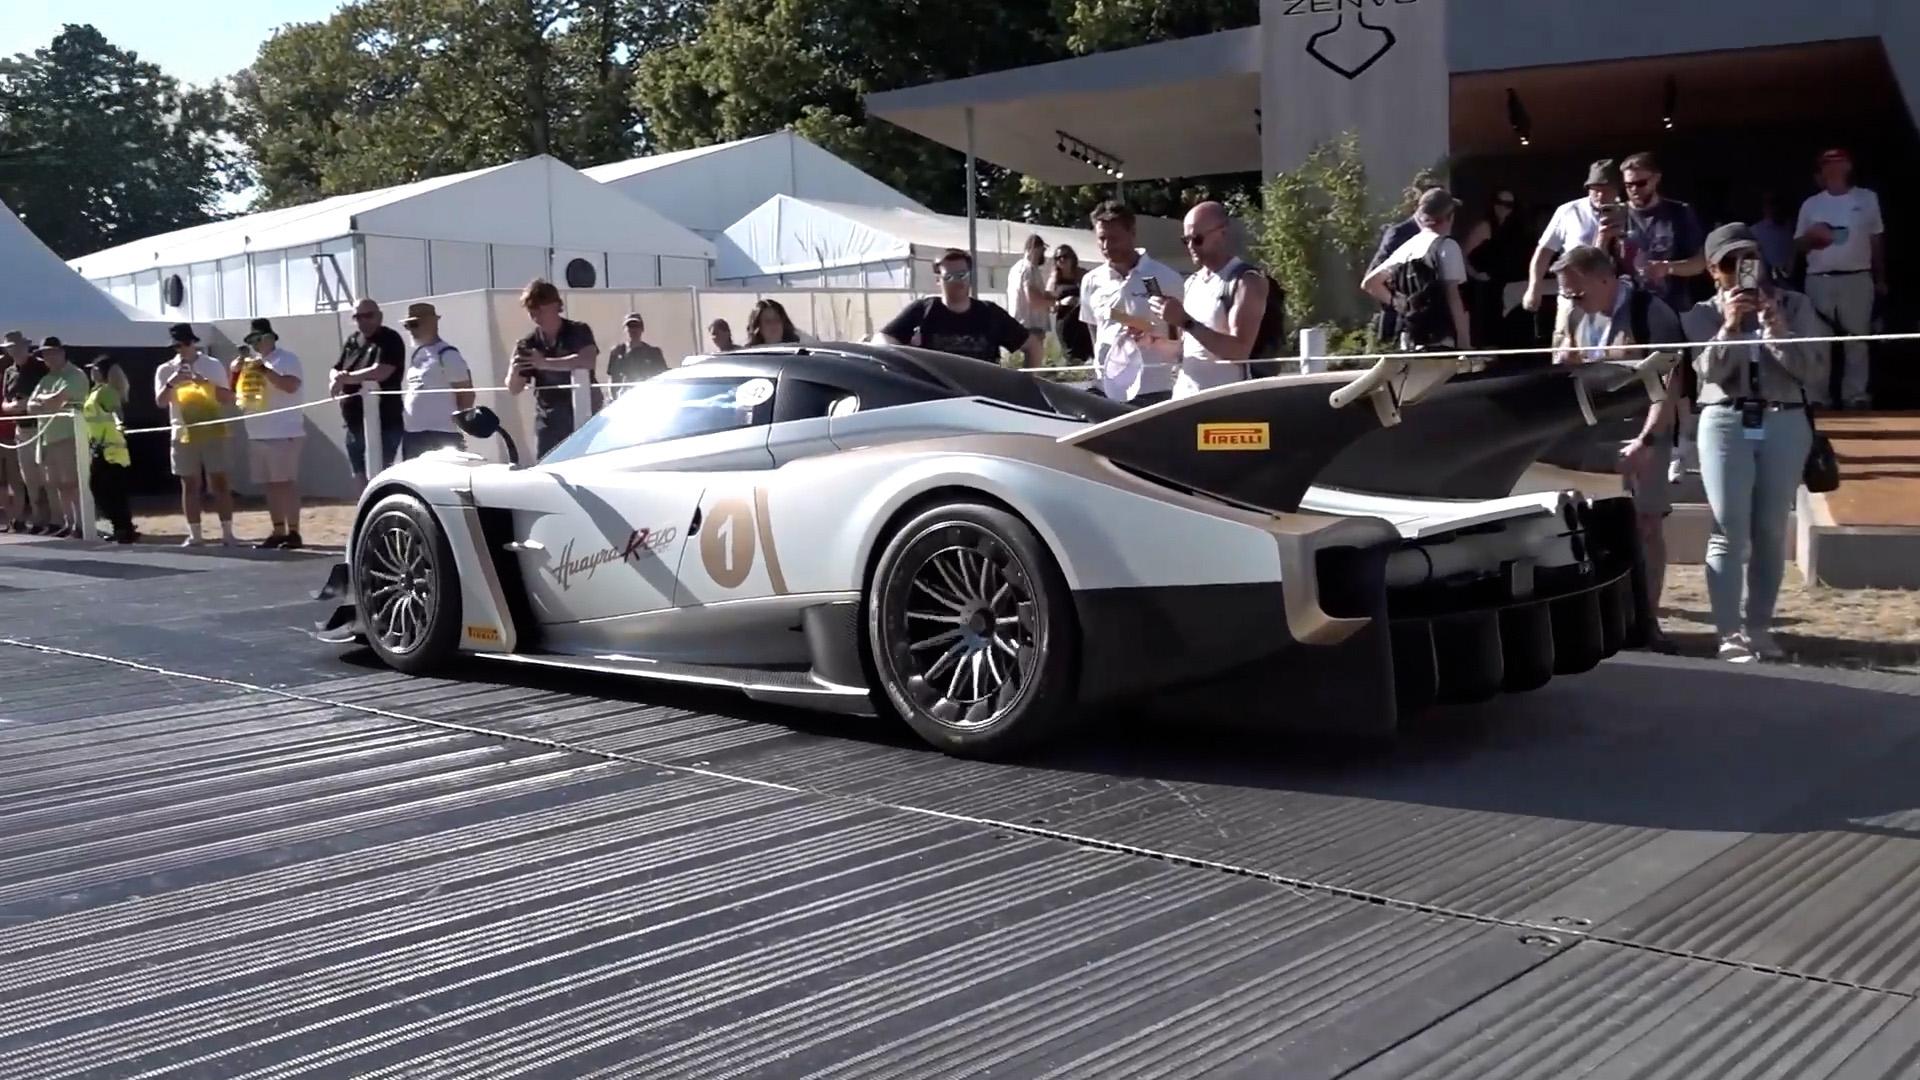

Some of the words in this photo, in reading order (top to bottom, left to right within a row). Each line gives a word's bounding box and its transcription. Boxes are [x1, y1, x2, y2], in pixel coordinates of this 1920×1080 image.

[1203, 428, 1263, 445] PIRELLI
[552, 537, 624, 592] Huayra
[717, 514, 733, 571] 1
